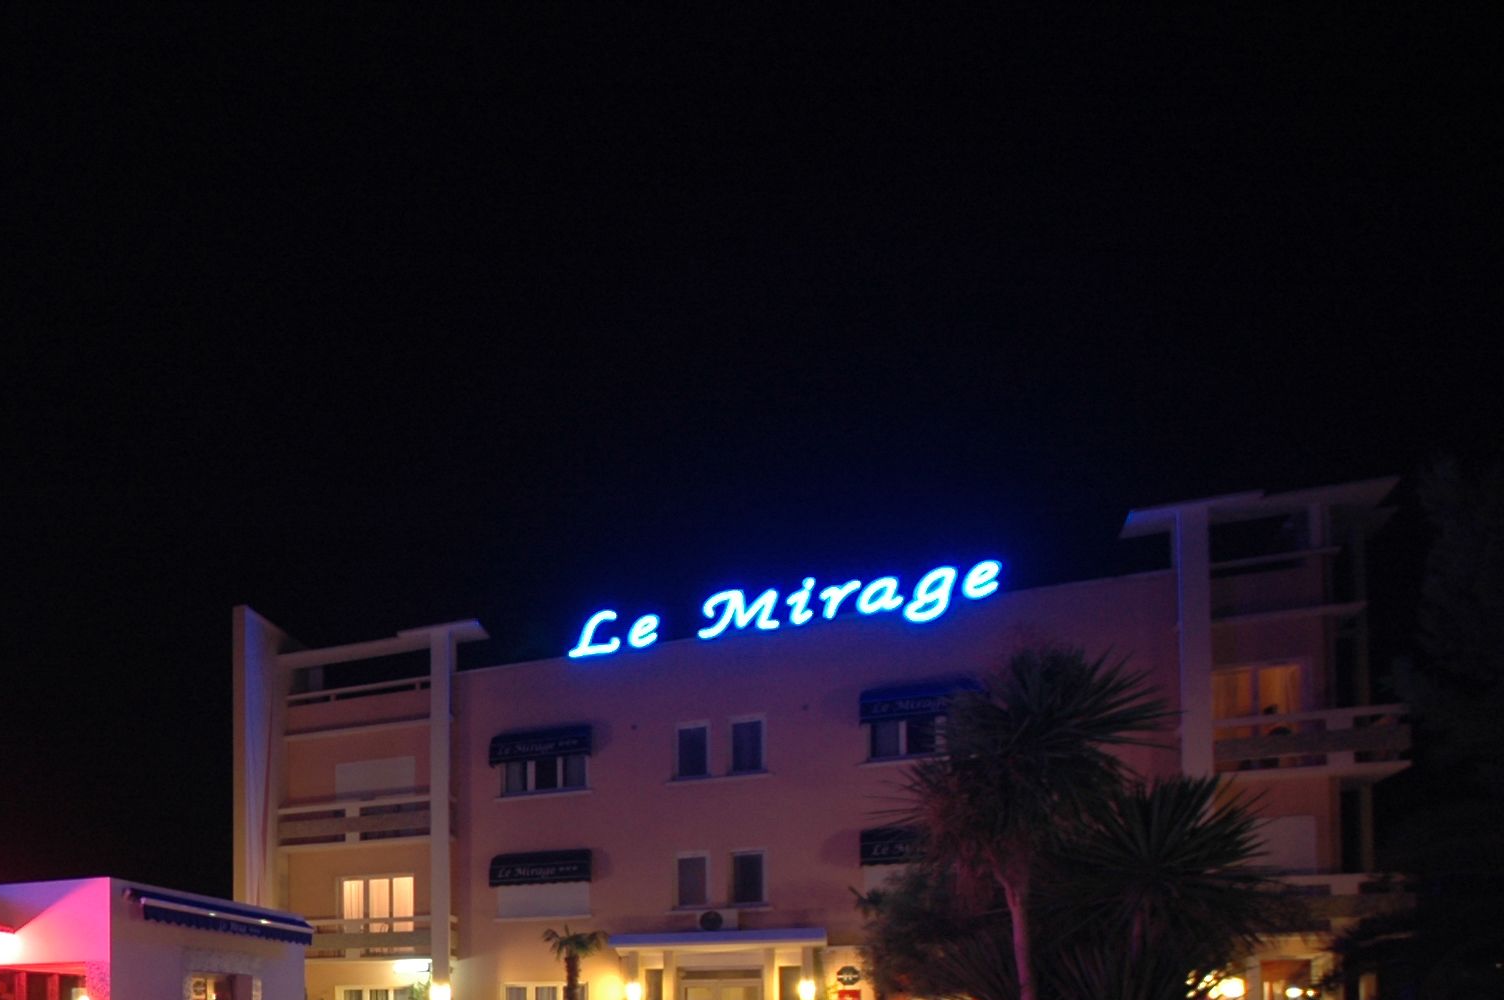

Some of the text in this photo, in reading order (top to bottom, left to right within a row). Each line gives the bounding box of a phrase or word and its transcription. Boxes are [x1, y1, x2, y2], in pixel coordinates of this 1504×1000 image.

[569, 559, 1002, 658] Le Mirage
[497, 744, 511, 756] Le
[497, 865, 556, 879] Le Mirage
